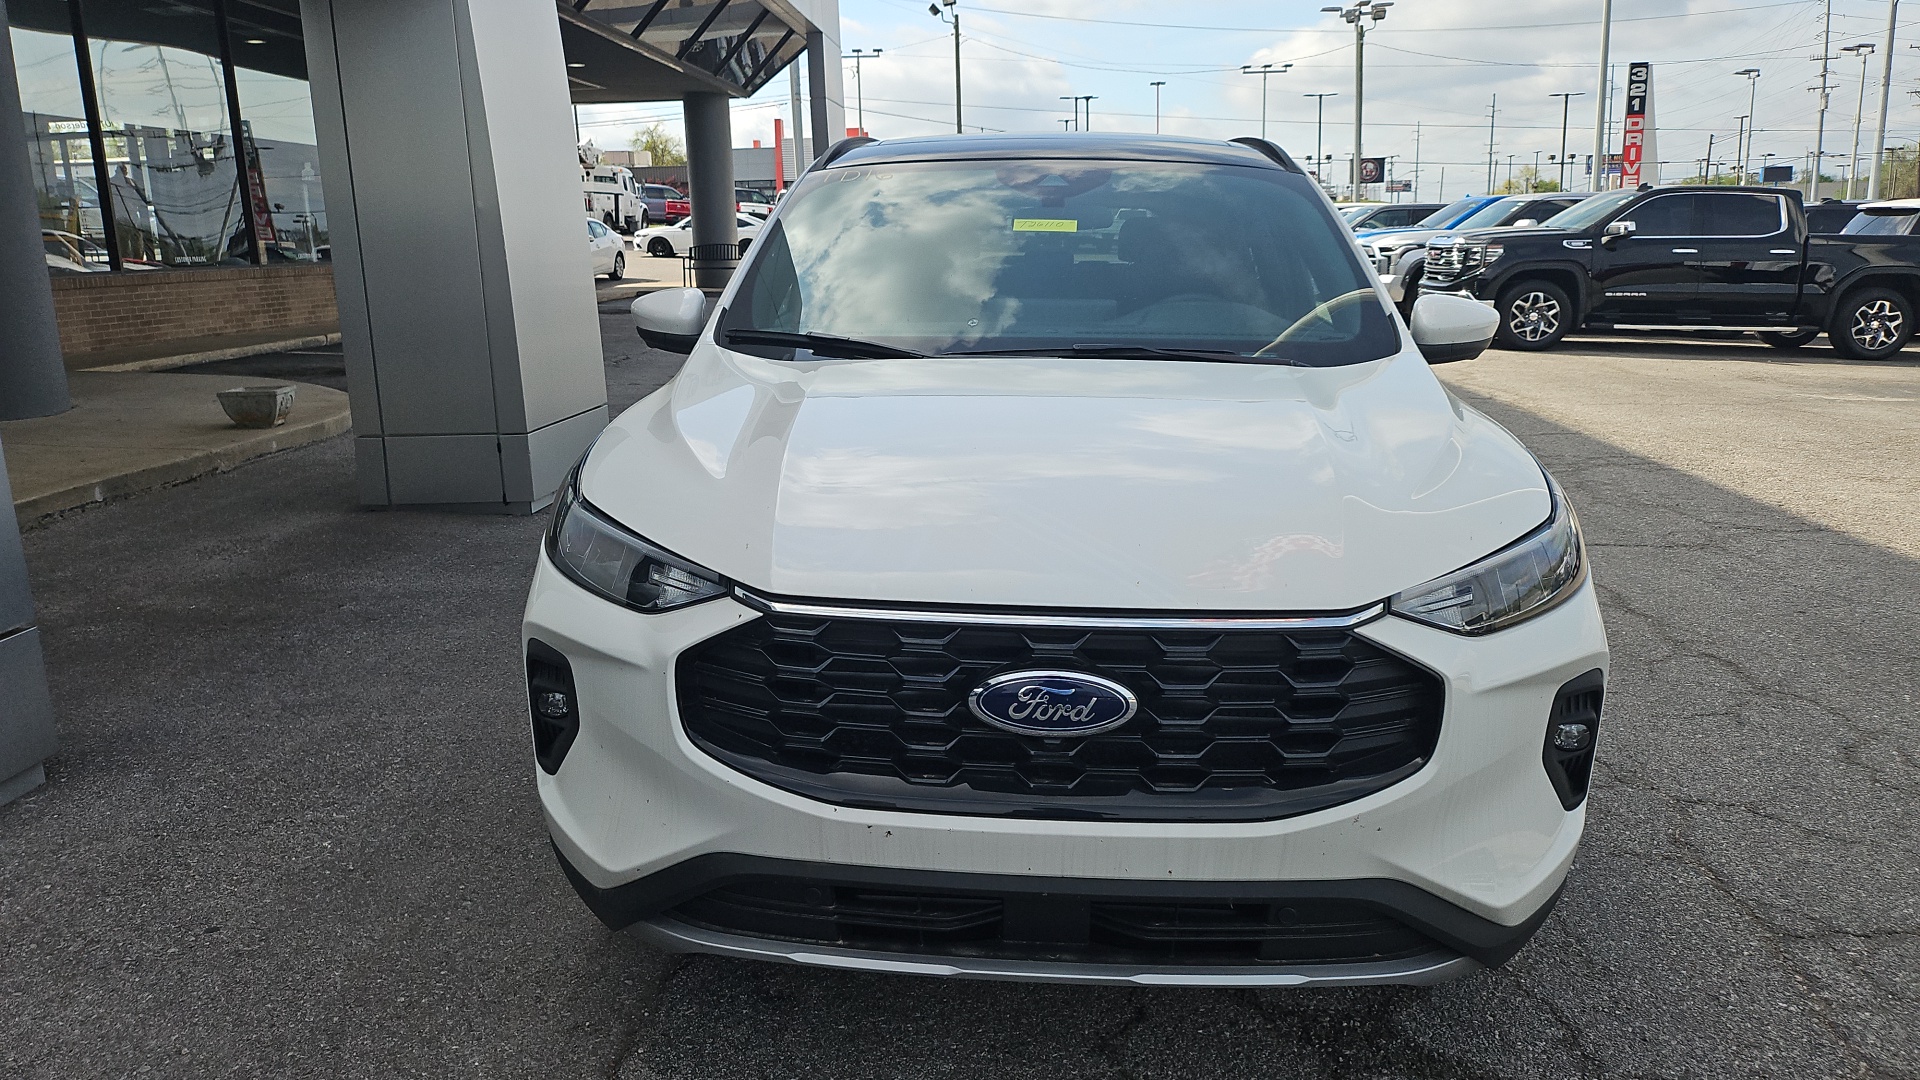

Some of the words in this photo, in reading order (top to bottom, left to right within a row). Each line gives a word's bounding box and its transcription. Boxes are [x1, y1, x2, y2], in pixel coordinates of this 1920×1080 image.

[1629, 67, 1647, 112] 321
[1622, 117, 1644, 188] DRIVE
[1008, 685, 1098, 722] Ford
